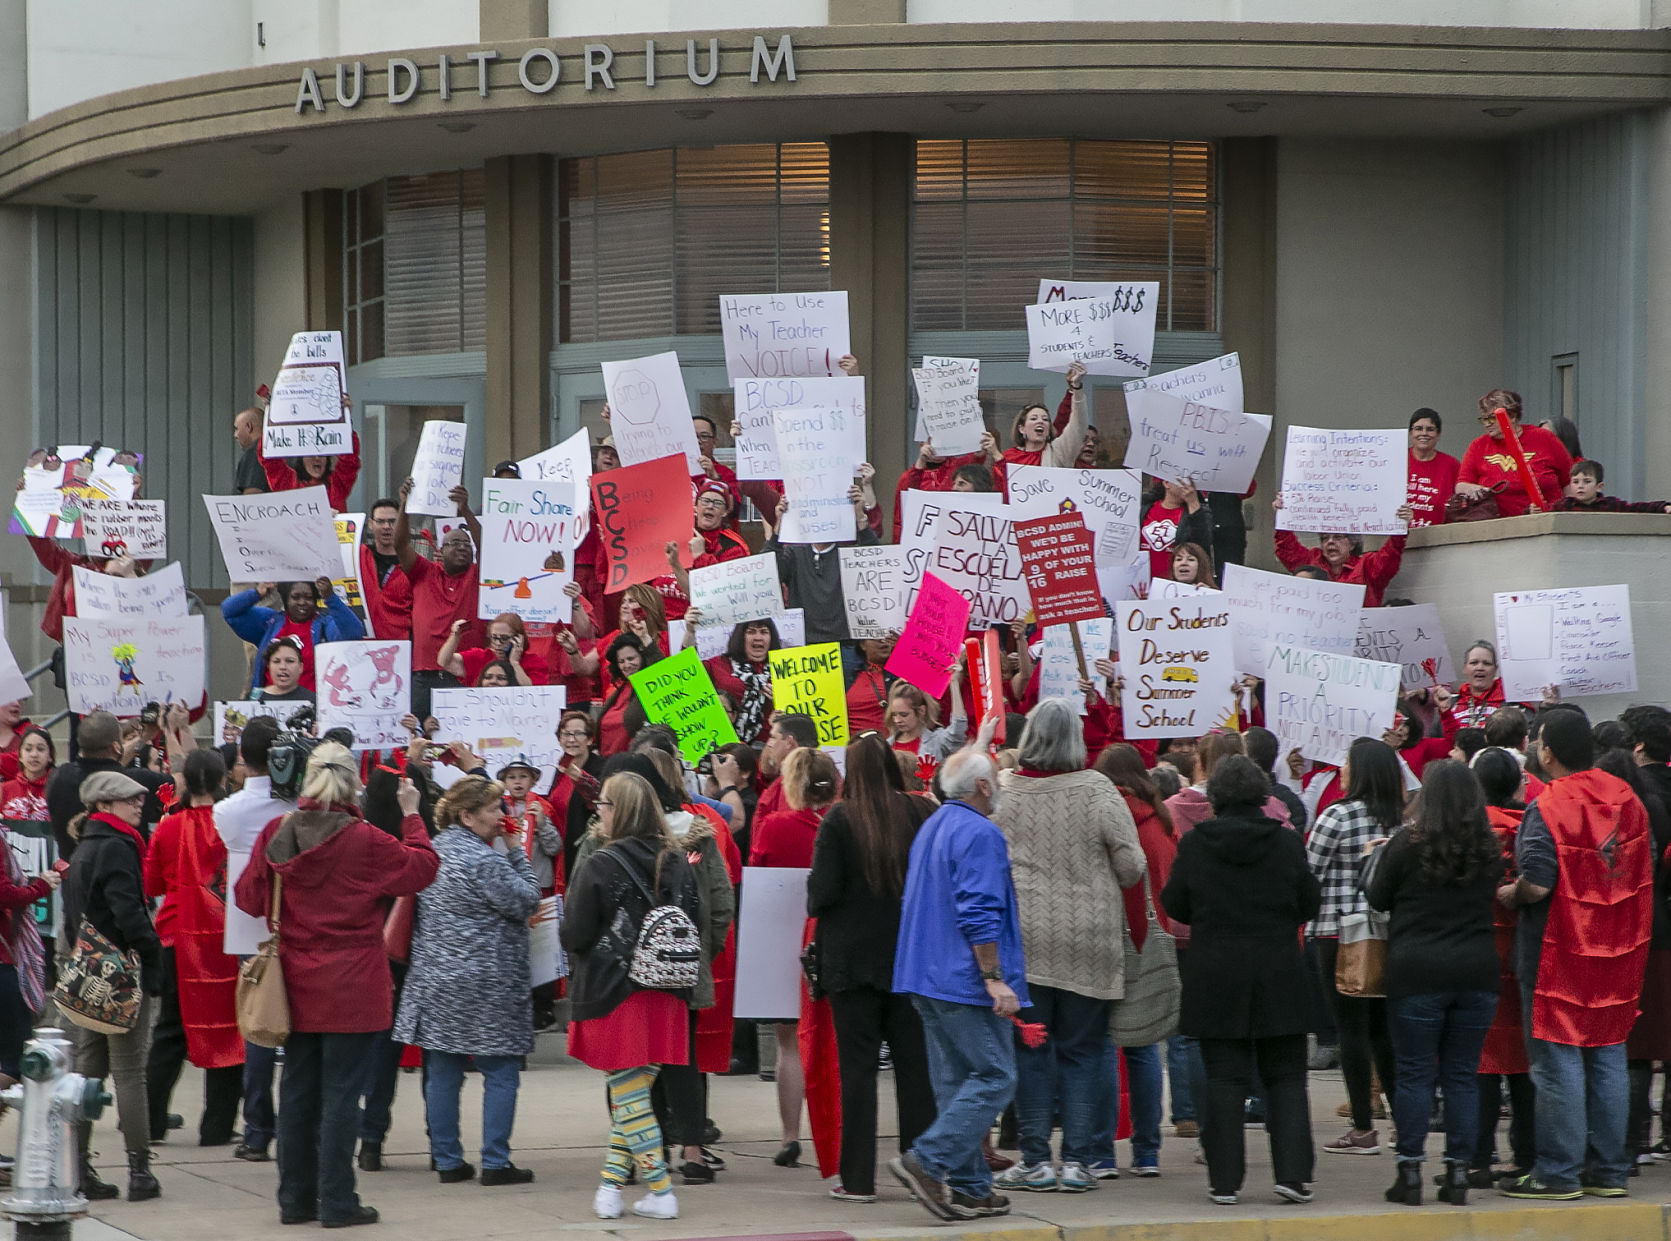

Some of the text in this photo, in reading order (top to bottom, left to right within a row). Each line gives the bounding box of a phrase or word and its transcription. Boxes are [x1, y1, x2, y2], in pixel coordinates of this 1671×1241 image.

[295, 35, 797, 114] AUDITORIUM
[725, 295, 825, 320] Here to Use
[1041, 308, 1083, 327] MORE
[739, 318, 829, 350] My Teacher
[1040, 340, 1085, 354] STUDENTS
[1072, 348, 1113, 361] TEACHERS
[740, 347, 832, 377] VOICE!
[616, 381, 650, 403] STOP
[265, 430, 292, 451] Make
[315, 427, 342, 446] Rain
[1140, 417, 1178, 445] treat
[1186, 439, 1206, 452] us
[738, 440, 772, 453] When
[1147, 443, 1222, 482] Respect
[1010, 470, 1137, 503] Save Summer
[100, 500, 122, 512] ARE
[215, 502, 321, 524] ENCROACH
[487, 489, 573, 516] Fair Share
[1083, 490, 1129, 518] School
[503, 519, 565, 544] NOW!
[1016, 520, 1083, 539] BCSD ADMIN!
[1030, 533, 1075, 548] WE'D BE
[854, 547, 884, 557] BCSD
[981, 541, 1009, 558] LA
[1022, 543, 1089, 563] HAPPY WITH
[727, 556, 765, 577] Board
[842, 557, 901, 568] TEACHERS
[1030, 555, 1092, 575] 9 OF YOUR
[712, 579, 746, 595] worked
[856, 570, 894, 594] ARE
[978, 575, 1001, 595] DE
[1029, 568, 1088, 589] 16 RAISE
[753, 590, 775, 604] you
[1228, 596, 1263, 608] much
[1276, 584, 1310, 600] paid
[1316, 591, 1344, 604] too
[1039, 612, 1055, 620] ask
[1128, 607, 1229, 632] Our Students
[66, 626, 91, 649] My
[1275, 632, 1295, 645] no
[1140, 638, 1211, 666] Deserve
[771, 648, 839, 680] WELCOME
[70, 671, 110, 688] BCSD
[645, 664, 698, 694] DID YOU
[791, 678, 817, 700] TO
[1136, 674, 1197, 701] Summer
[435, 690, 458, 709] I
[652, 687, 690, 712] THINK
[1311, 683, 1328, 705] A
[677, 692, 716, 720] WOULDN'T
[1136, 704, 1196, 729] School
[1278, 691, 1376, 735] PRIORITY
[675, 719, 707, 741] SHOW
[1277, 718, 1303, 741] NOT
